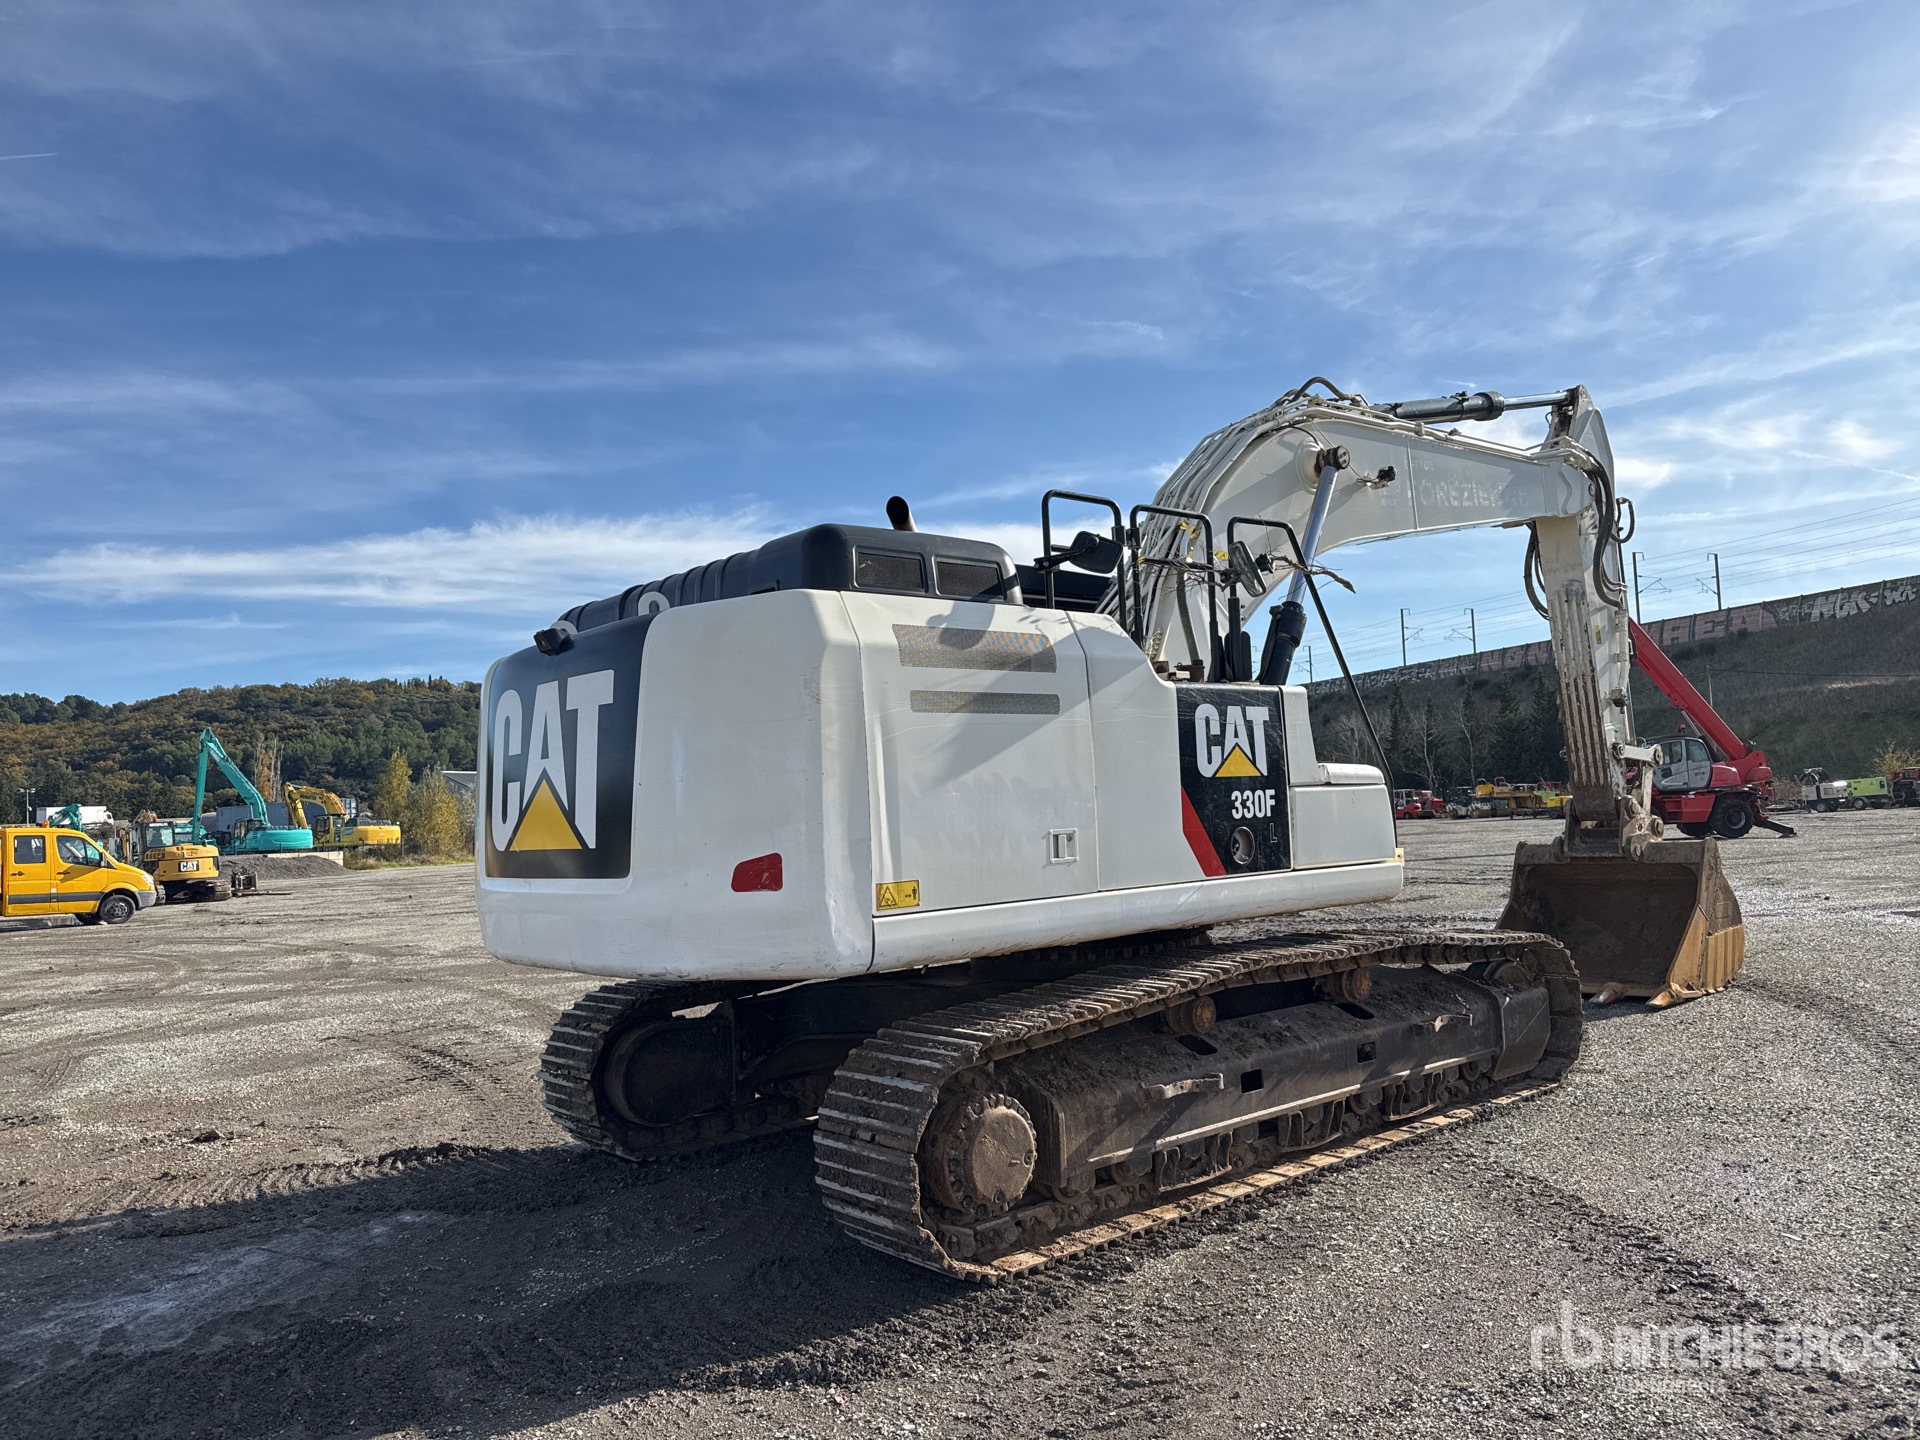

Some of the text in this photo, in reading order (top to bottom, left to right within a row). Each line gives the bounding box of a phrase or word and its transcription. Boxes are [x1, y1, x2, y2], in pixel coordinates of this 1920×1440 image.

[492, 669, 615, 852] CAT
[1195, 703, 1270, 778] CAT
[1231, 789, 1276, 820] 330F
[180, 861, 198, 872] CAT
